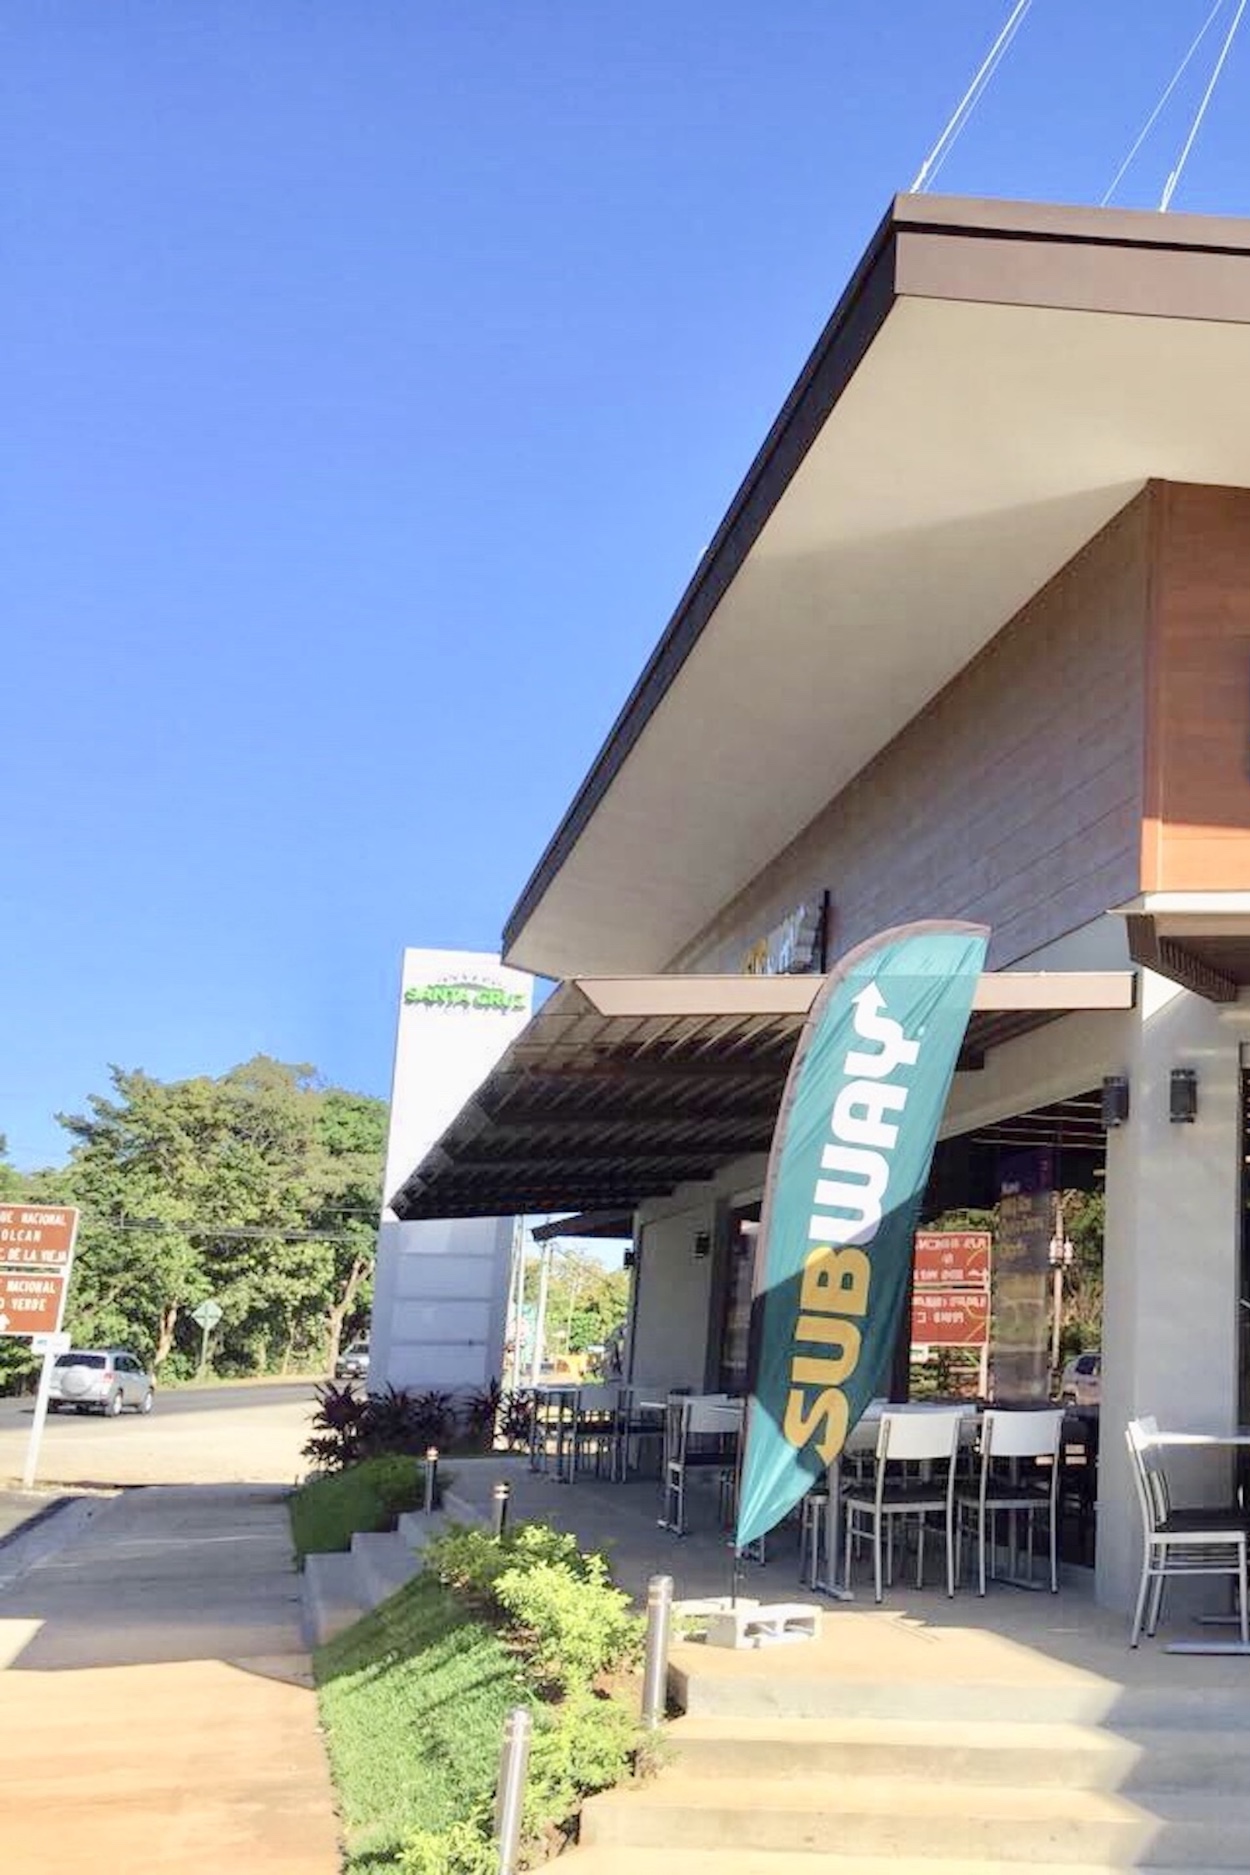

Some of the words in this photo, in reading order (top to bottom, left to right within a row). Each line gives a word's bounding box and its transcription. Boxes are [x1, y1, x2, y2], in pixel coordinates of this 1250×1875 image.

[20, 1211, 67, 1226] NACIONAL
[783, 980, 921, 1468] SUBWAY
[0, 1228, 42, 1242] OLCAN
[6, 1280, 56, 1295] NACIONAL
